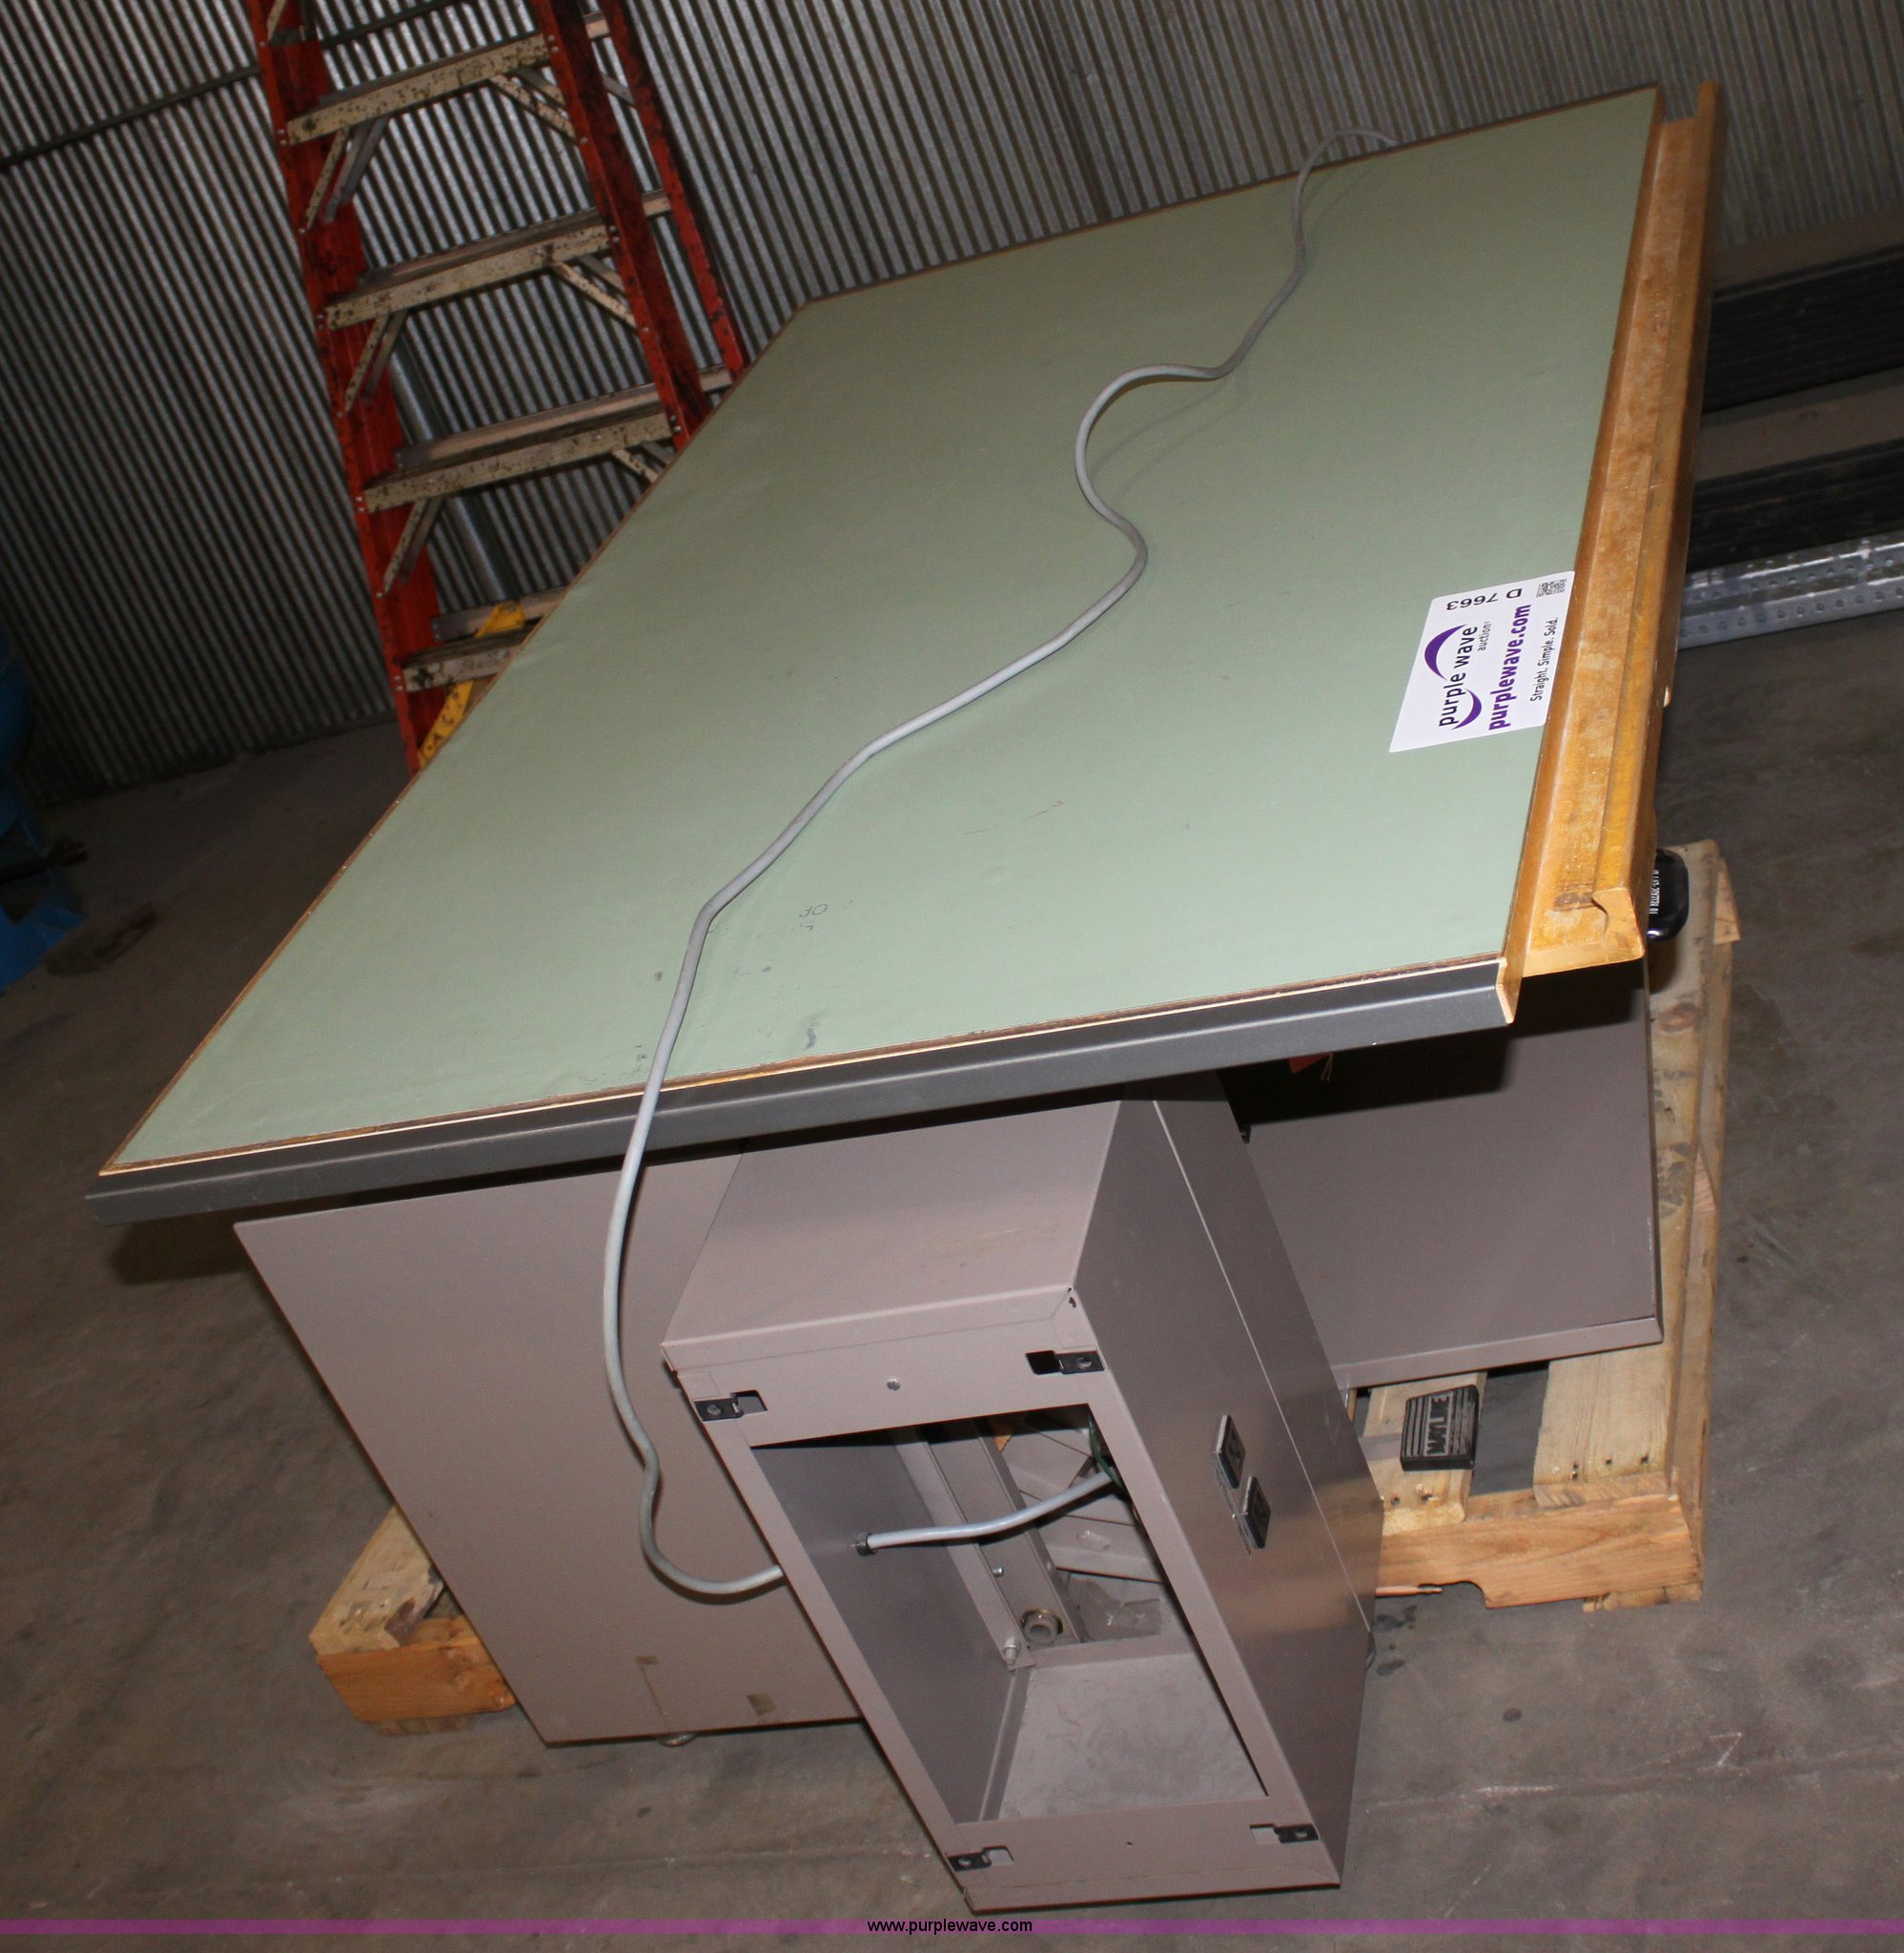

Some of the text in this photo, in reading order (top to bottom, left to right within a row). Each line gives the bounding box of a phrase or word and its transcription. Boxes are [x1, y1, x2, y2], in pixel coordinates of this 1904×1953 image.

[1446, 587, 1523, 611] D 7663
[1438, 626, 1478, 728] purple wave
[1488, 604, 1532, 730] purplewave.com
[1530, 616, 1559, 702] Straight. Simple. Sold.
